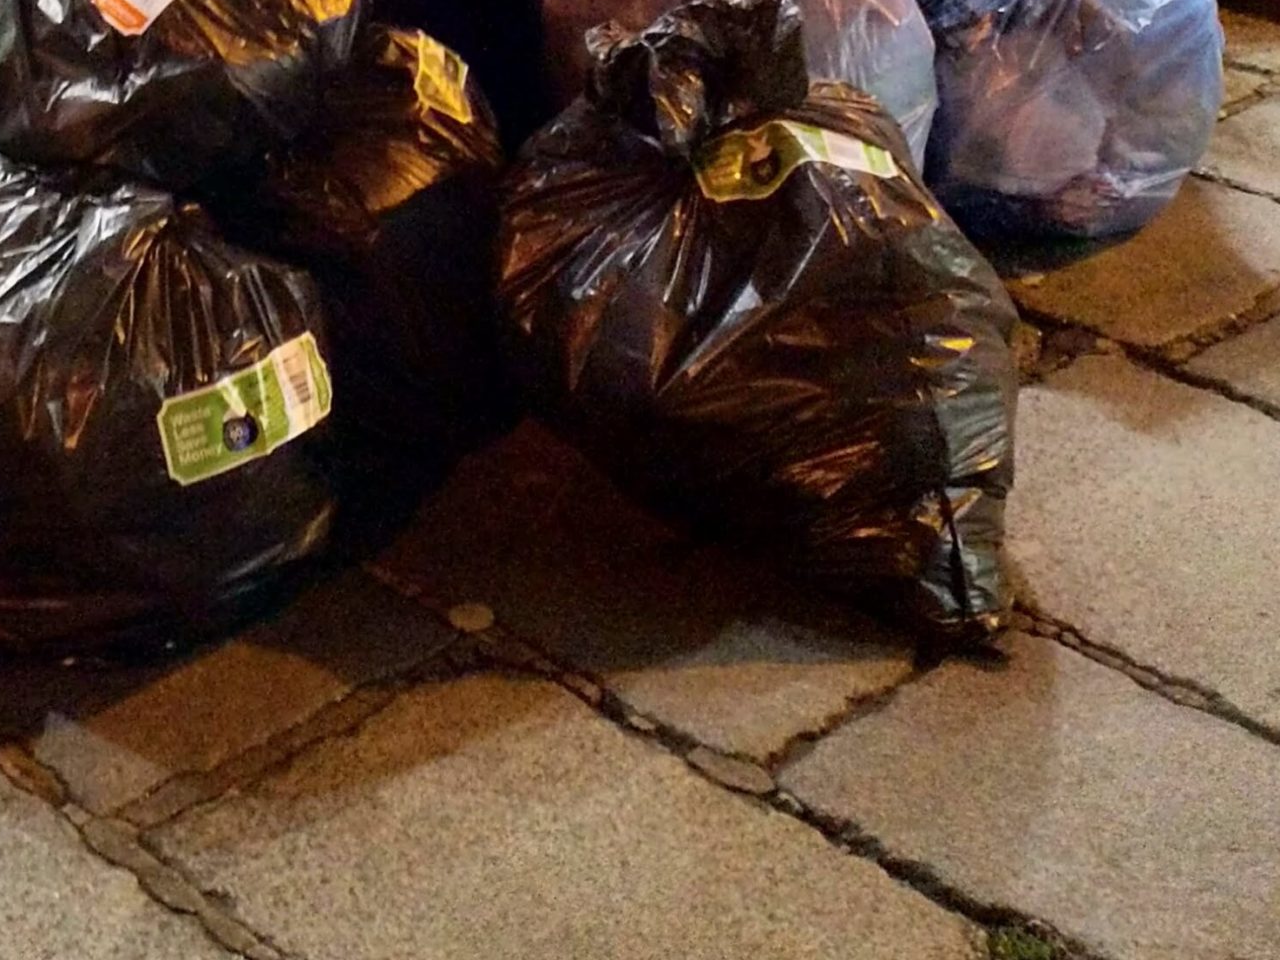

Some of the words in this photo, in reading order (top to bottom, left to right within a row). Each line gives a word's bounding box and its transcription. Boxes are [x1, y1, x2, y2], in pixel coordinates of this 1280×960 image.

[170, 407, 211, 426] Waste
[173, 423, 205, 440] Less
[177, 436, 208, 451] Save
[178, 443, 222, 464] Money
